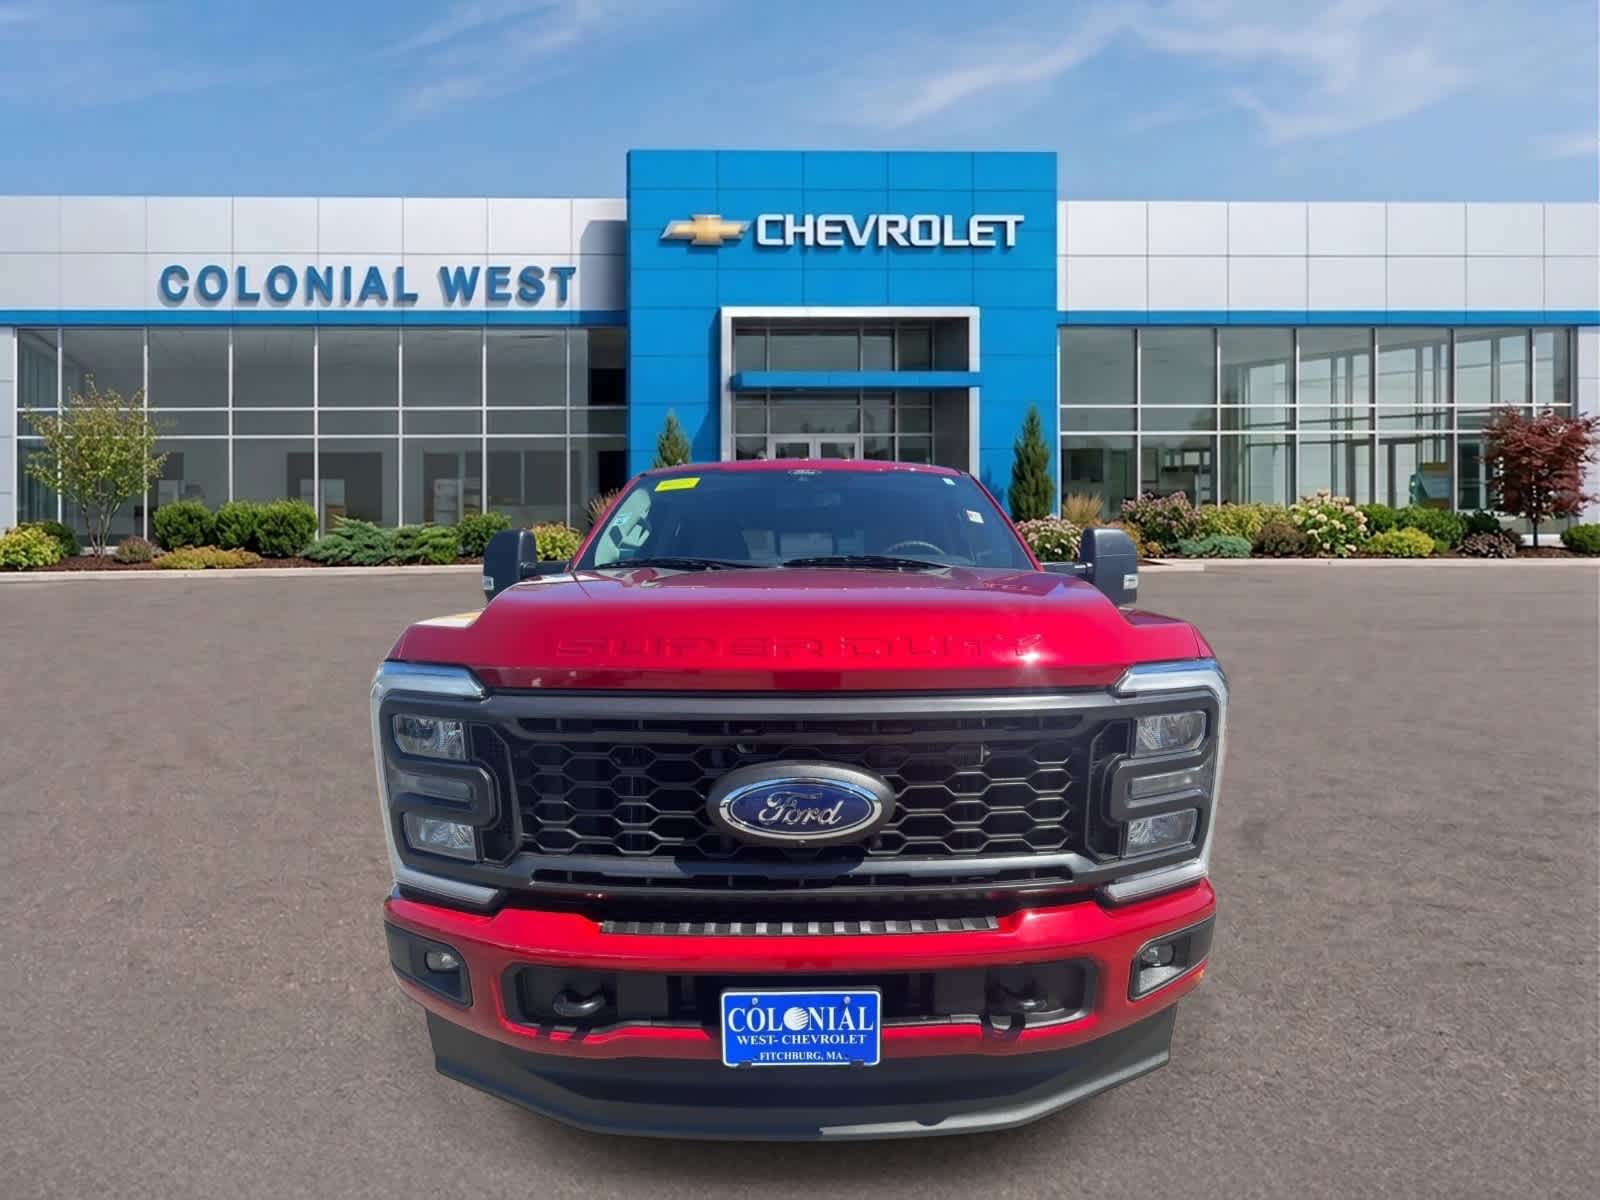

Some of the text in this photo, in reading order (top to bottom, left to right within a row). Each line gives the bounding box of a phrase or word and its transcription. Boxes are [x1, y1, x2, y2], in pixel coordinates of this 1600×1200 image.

[757, 214, 1025, 247] CHEVROLET
[159, 264, 577, 303] COLONIAL WEST
[556, 634, 1042, 658] SUPER DUTY
[758, 791, 844, 825] Ford
[728, 1006, 874, 1032] COLONIAL
[782, 1034, 866, 1045] CHEVROLET
[759, 1051, 824, 1062] FITCHBURG,
